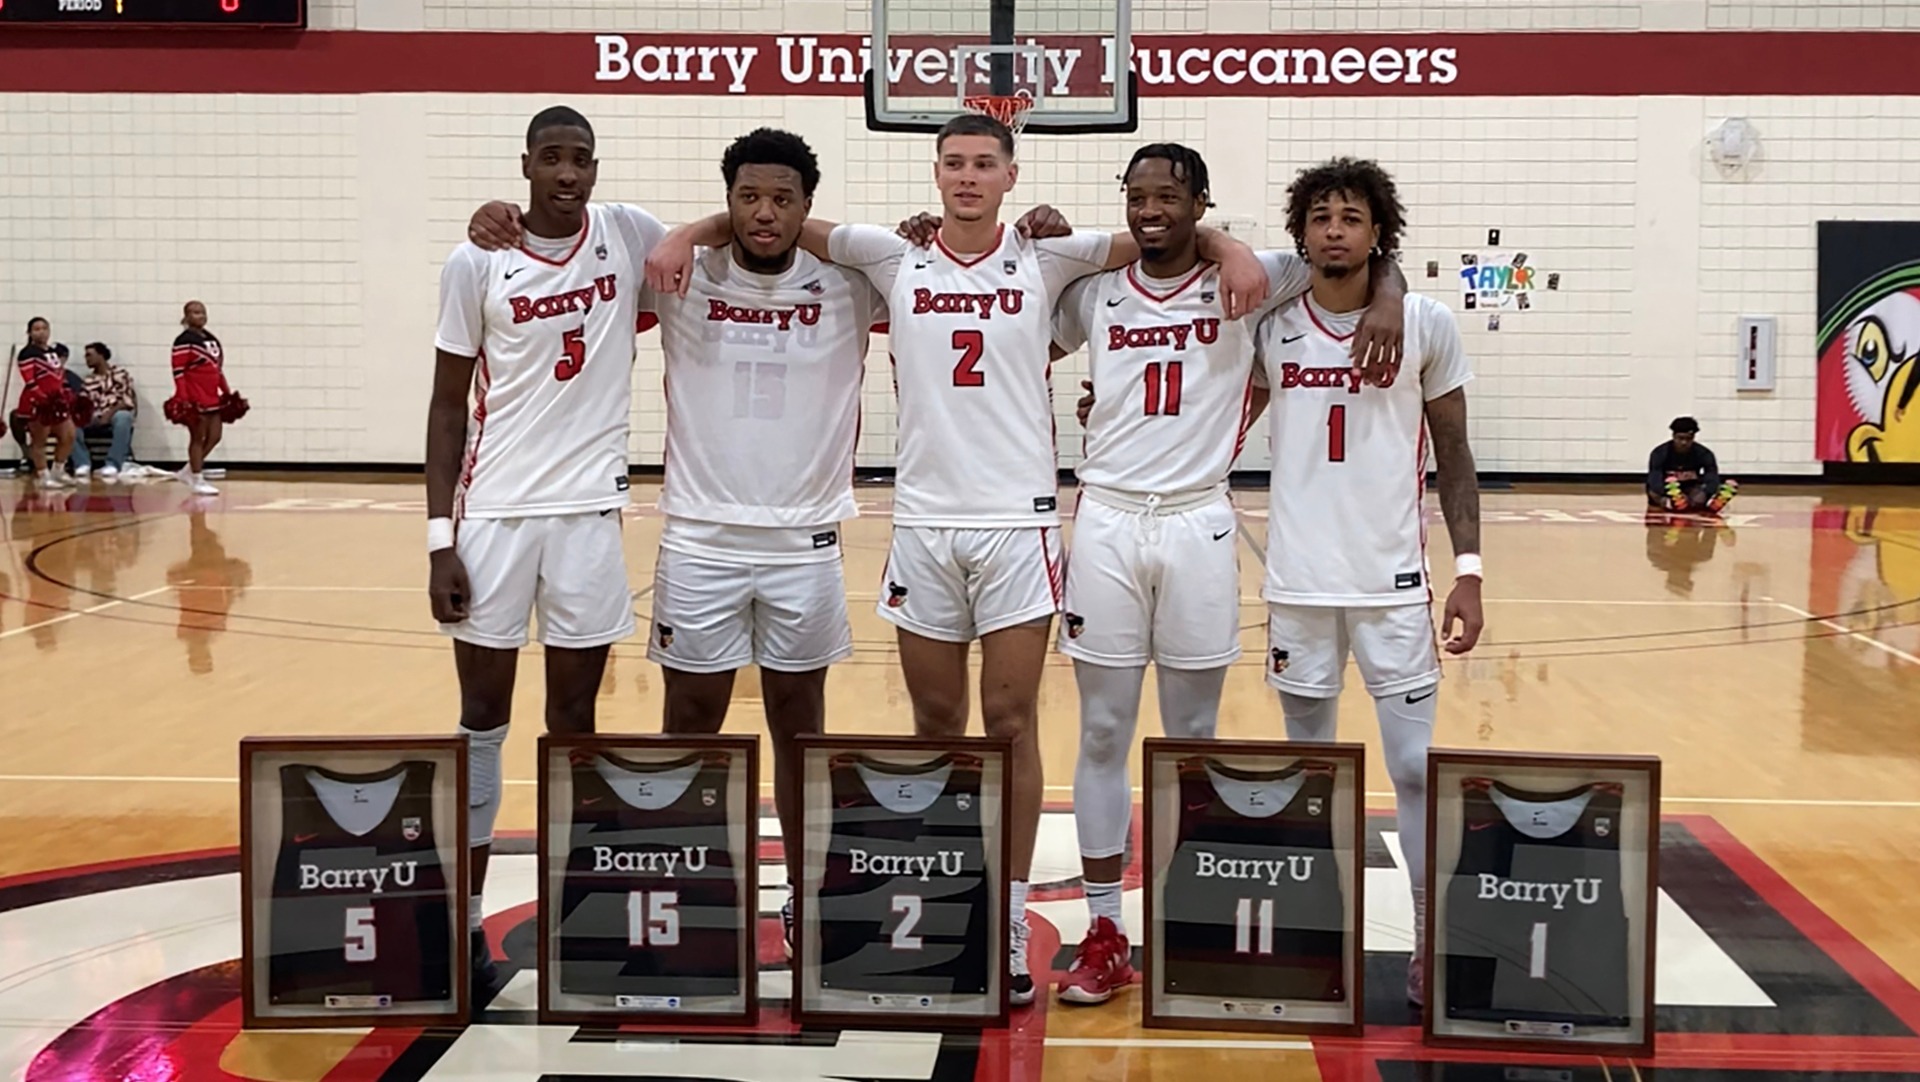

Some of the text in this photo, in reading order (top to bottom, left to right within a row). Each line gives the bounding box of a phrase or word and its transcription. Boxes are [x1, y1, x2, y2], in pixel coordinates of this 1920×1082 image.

[594, 35, 758, 93] Barry
[776, 37, 1082, 95] Universty
[554, 322, 586, 382] 5
[952, 330, 985, 387] 2
[1143, 361, 1183, 416] 11
[1327, 404, 1346, 462] 1
[344, 907, 377, 962] 5
[627, 891, 680, 946] 15
[890, 895, 923, 949] 2
[1235, 898, 1274, 954] 11
[1529, 922, 1548, 978] 1
